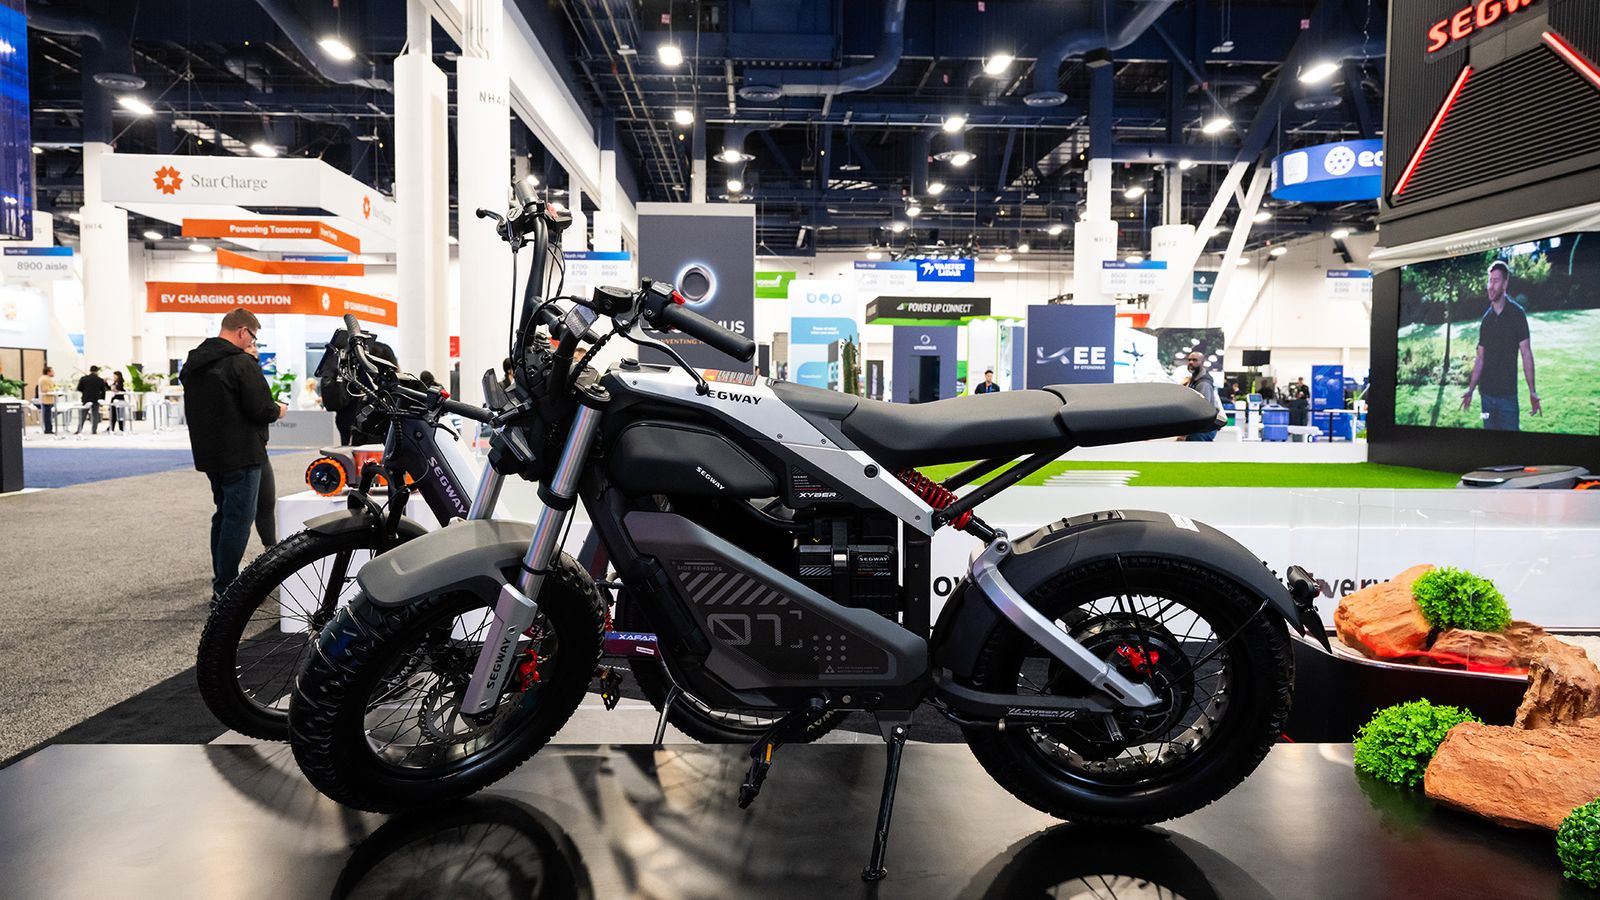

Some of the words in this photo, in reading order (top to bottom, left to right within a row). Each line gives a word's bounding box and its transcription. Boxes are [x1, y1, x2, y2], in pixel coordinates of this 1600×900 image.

[229, 224, 268, 235] Powering
[270, 225, 313, 234] Tomorrow
[17, 261, 43, 270] 8900
[44, 261, 68, 270] aisle
[161, 294, 175, 303] EV
[178, 294, 235, 304] CHARGING
[237, 295, 292, 305] SOLUTION
[908, 303, 932, 312] POWER
[932, 304, 942, 312] UP
[942, 304, 971, 313] CONNECT
[695, 389, 762, 405] EGWAY
[428, 456, 467, 513] SEGWAY
[695, 466, 725, 490] SEGWAY
[486, 638, 511, 689] SEGWAY
